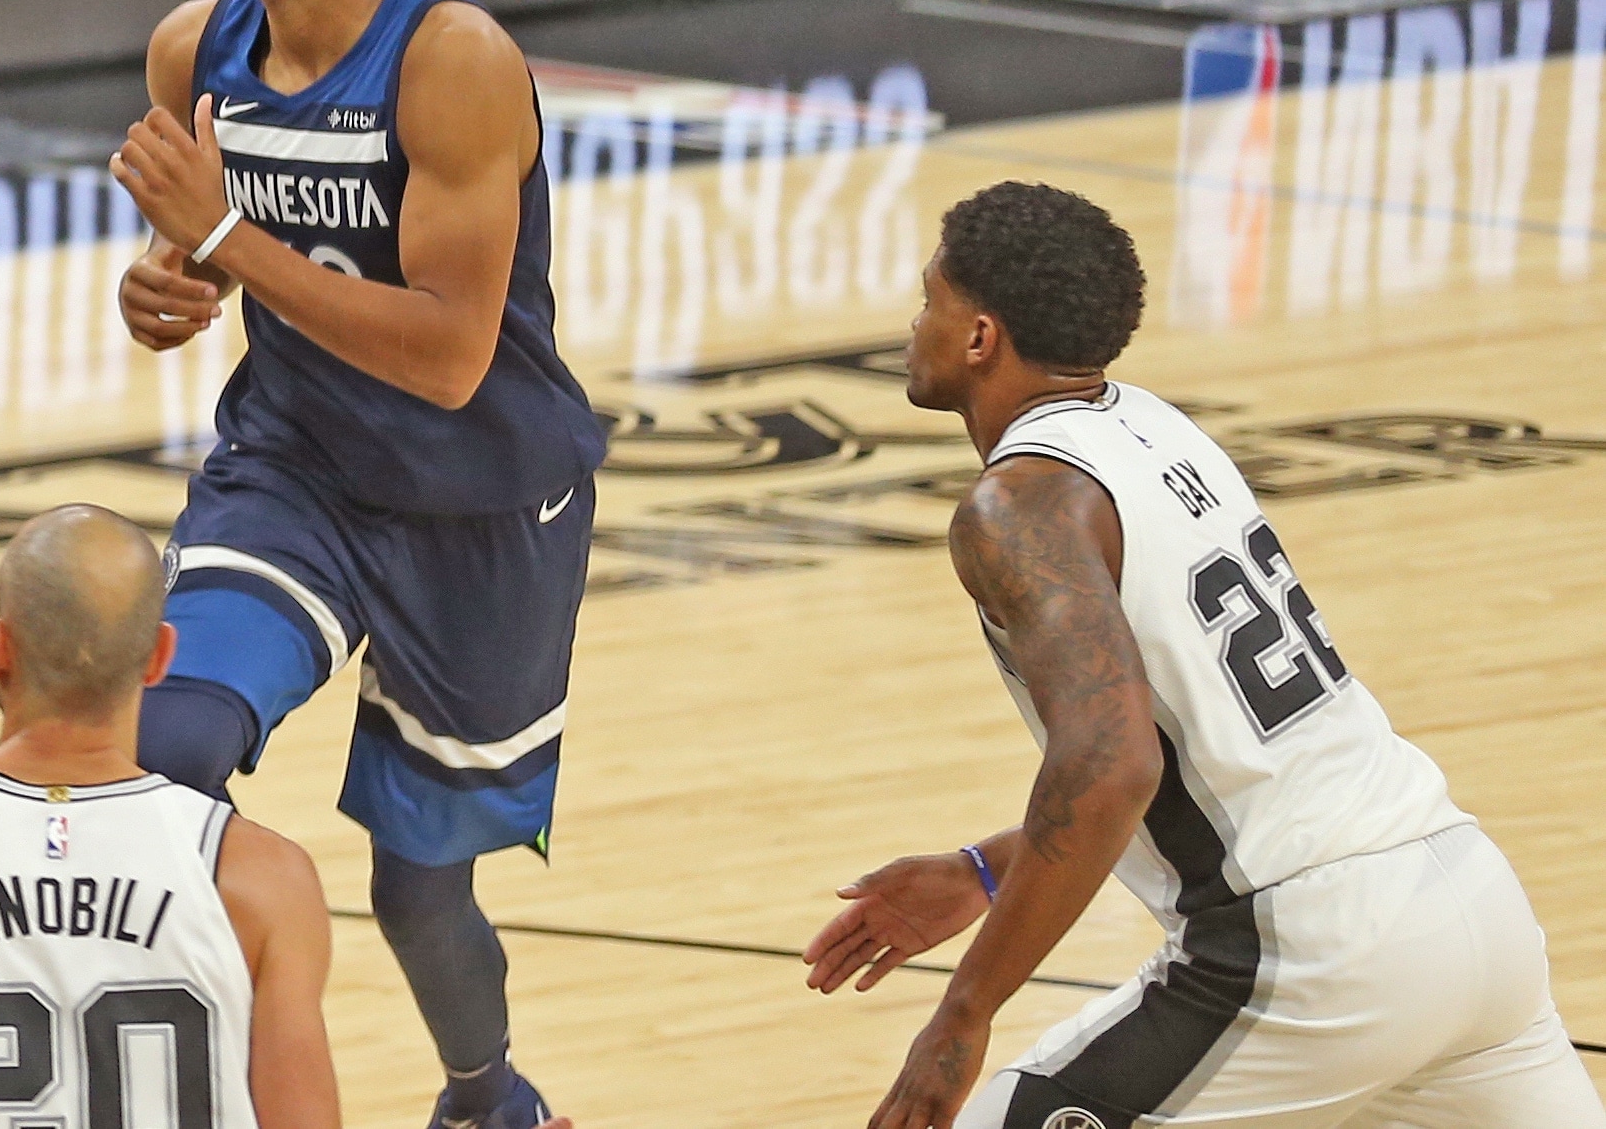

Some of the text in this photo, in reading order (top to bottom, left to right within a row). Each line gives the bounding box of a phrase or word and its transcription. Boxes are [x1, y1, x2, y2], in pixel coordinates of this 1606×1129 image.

[224, 167, 390, 229] INNESOTA
[1162, 458, 1221, 520] GAY
[1187, 514, 1354, 746] 22
